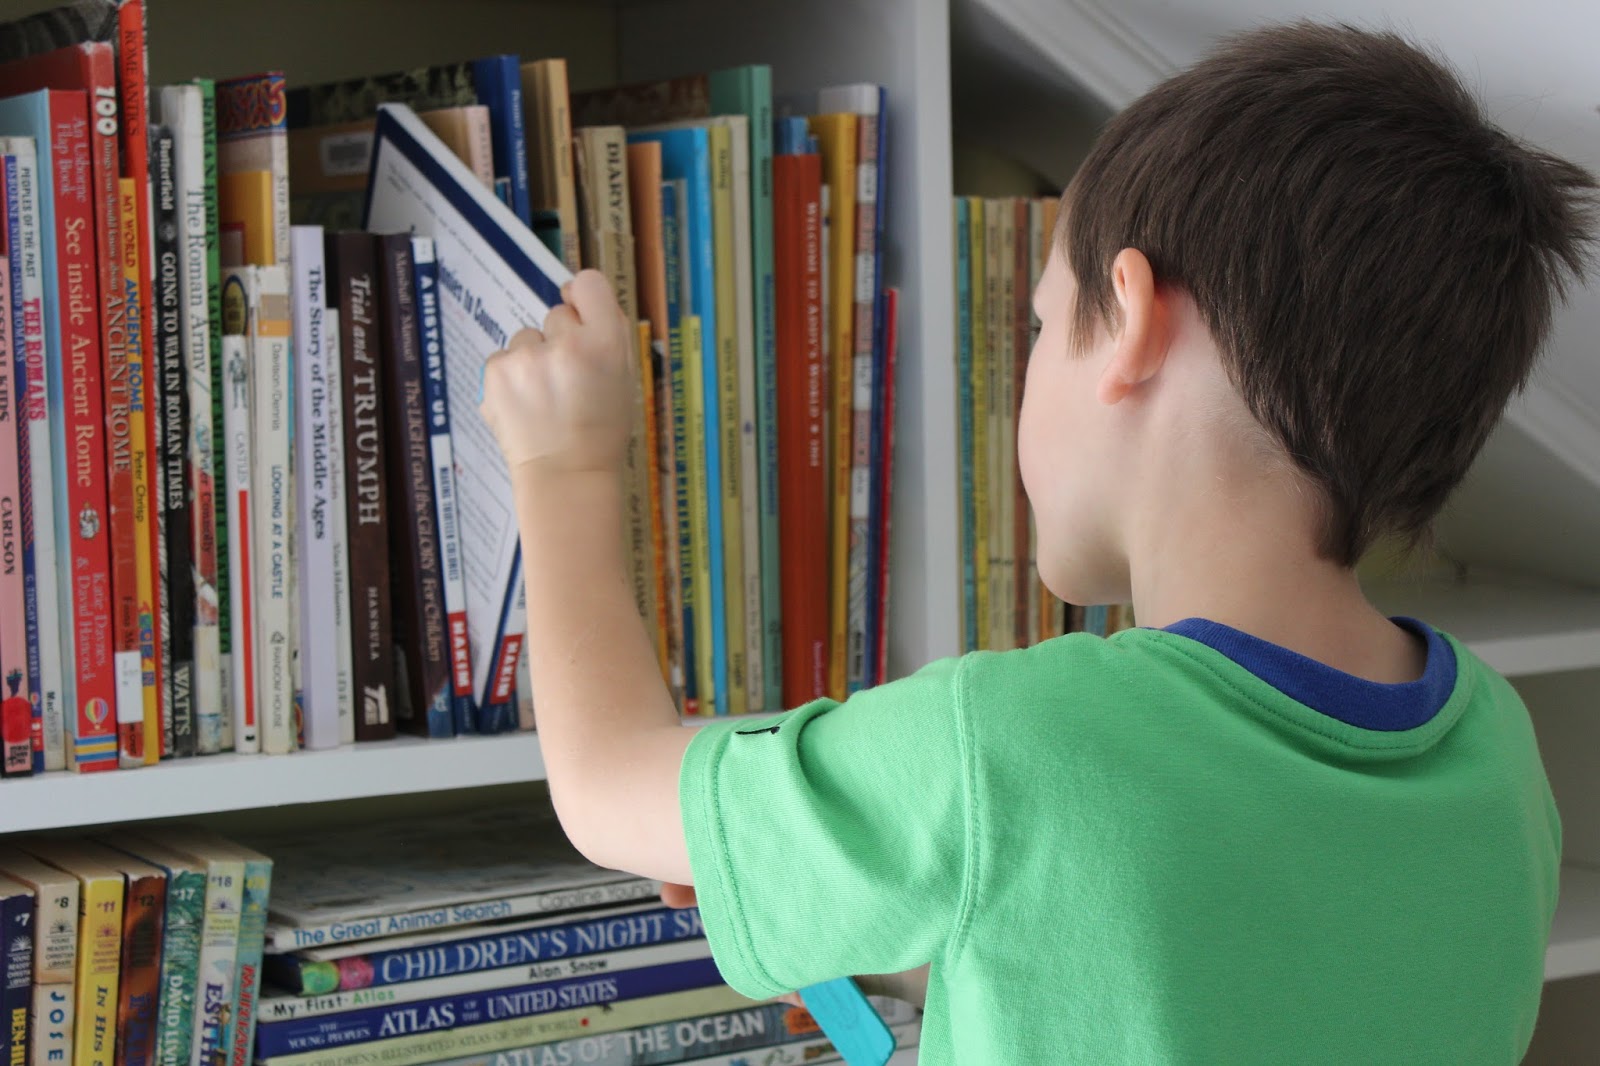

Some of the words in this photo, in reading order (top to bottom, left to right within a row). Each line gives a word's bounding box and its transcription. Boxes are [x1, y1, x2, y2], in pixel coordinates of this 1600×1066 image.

[125, 30, 139, 73] ROME
[94, 86, 118, 136] 100
[20, 168, 36, 212] PEOPLES
[160, 139, 174, 211] Butterfield
[23, 215, 36, 226] OF
[123, 195, 135, 214] MY
[186, 190, 206, 230] The
[24, 231, 36, 249] THE
[65, 217, 86, 256] See
[124, 220, 137, 268] WORLD
[25, 253, 37, 279] PAST
[161, 252, 178, 306] GOING
[189, 234, 207, 307] Roman
[308, 266, 323, 303] The
[422, 275, 434, 290] A
[23, 298, 42, 332] THE
[68, 263, 92, 325] inside
[125, 278, 142, 355] ANCIENT
[349, 273, 374, 325] Trial
[163, 309, 179, 332] TO
[191, 313, 209, 373] Army
[307, 307, 325, 358] Story
[421, 292, 444, 381] HISTORY
[106, 294, 128, 399] ANCIENT
[164, 334, 180, 371] WAR
[351, 325, 376, 365] and
[25, 340, 47, 422] ROMANS
[71, 333, 94, 417] Ancient
[128, 362, 144, 413] ROME
[166, 373, 181, 390] IN
[310, 363, 325, 384] of
[404, 380, 422, 405] The
[311, 385, 326, 418] the
[430, 398, 447, 428] US
[111, 402, 131, 475] ROME
[166, 395, 182, 456] ROMAN
[353, 367, 382, 526] TRIUMPH
[407, 407, 426, 458] LIGHT
[75, 424, 95, 488] Rome
[135, 450, 146, 481] Peter
[312, 422, 329, 491] Middle
[411, 460, 428, 490] and
[135, 485, 147, 523] Chrisp
[168, 458, 184, 510] TIMES
[271, 465, 283, 518] LOOKING
[1, 497, 16, 576] CARLSON
[271, 522, 283, 537] AT
[311, 496, 328, 540] Ages
[271, 541, 283, 550] A
[416, 516, 435, 571] GLORY
[78, 574, 96, 617] David
[271, 553, 284, 599] CASTLE
[80, 622, 97, 683] Hancock
[452, 620, 471, 690] HAKIM
[496, 640, 521, 699] HAKIM
[173, 665, 192, 737] WATTS
[537, 887, 604, 911] Caroline
[605, 882, 654, 904] Young
[292, 928, 326, 946] The
[330, 919, 382, 942] Great
[388, 910, 448, 932] Animal
[452, 901, 513, 921] Search
[381, 928, 569, 984] CHILDREN'S
[572, 913, 667, 951] NIGHT
[672, 906, 705, 938] SK
[95, 985, 110, 1007] IN
[166, 975, 185, 1027] DAVID
[273, 1002, 297, 1018] My
[305, 995, 343, 1010] First
[352, 988, 396, 1006] Atlas
[528, 964, 562, 980] Alan
[570, 958, 609, 974] Snow
[487, 987, 558, 1020] UNITED
[558, 978, 619, 1009] STATES
[93, 1014, 107, 1053] HIS
[287, 1032, 326, 1050] YOUNG
[378, 1003, 457, 1039] ATLAS
[495, 1045, 574, 1066] ATLAS
[578, 1034, 618, 1063] OF
[622, 1023, 673, 1056] THE
[674, 1009, 767, 1048] OCEAN
